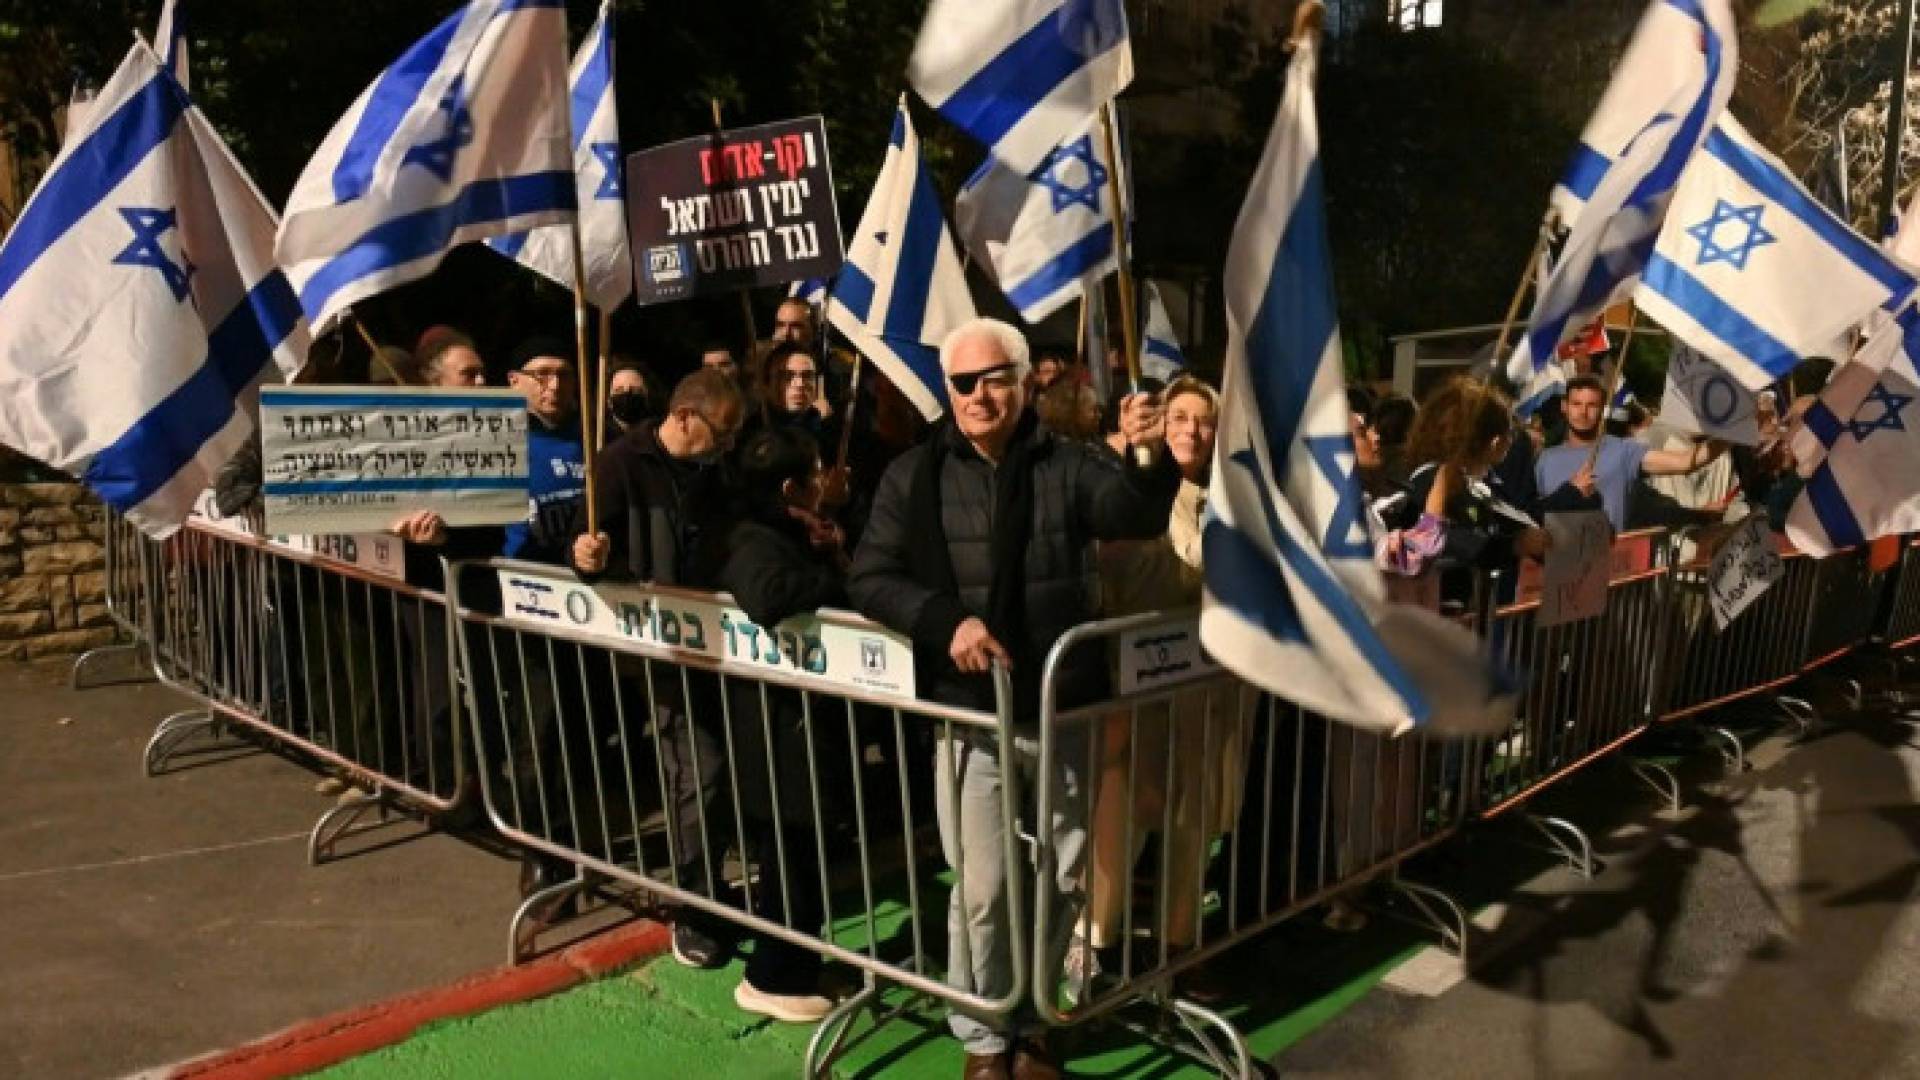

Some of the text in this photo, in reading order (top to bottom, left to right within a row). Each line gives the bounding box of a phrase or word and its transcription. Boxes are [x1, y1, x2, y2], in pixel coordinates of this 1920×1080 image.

[699, 132, 817, 185] וקו-אדם
[659, 178, 811, 236] ימין ושמאל
[775, 221, 820, 261] נגד
